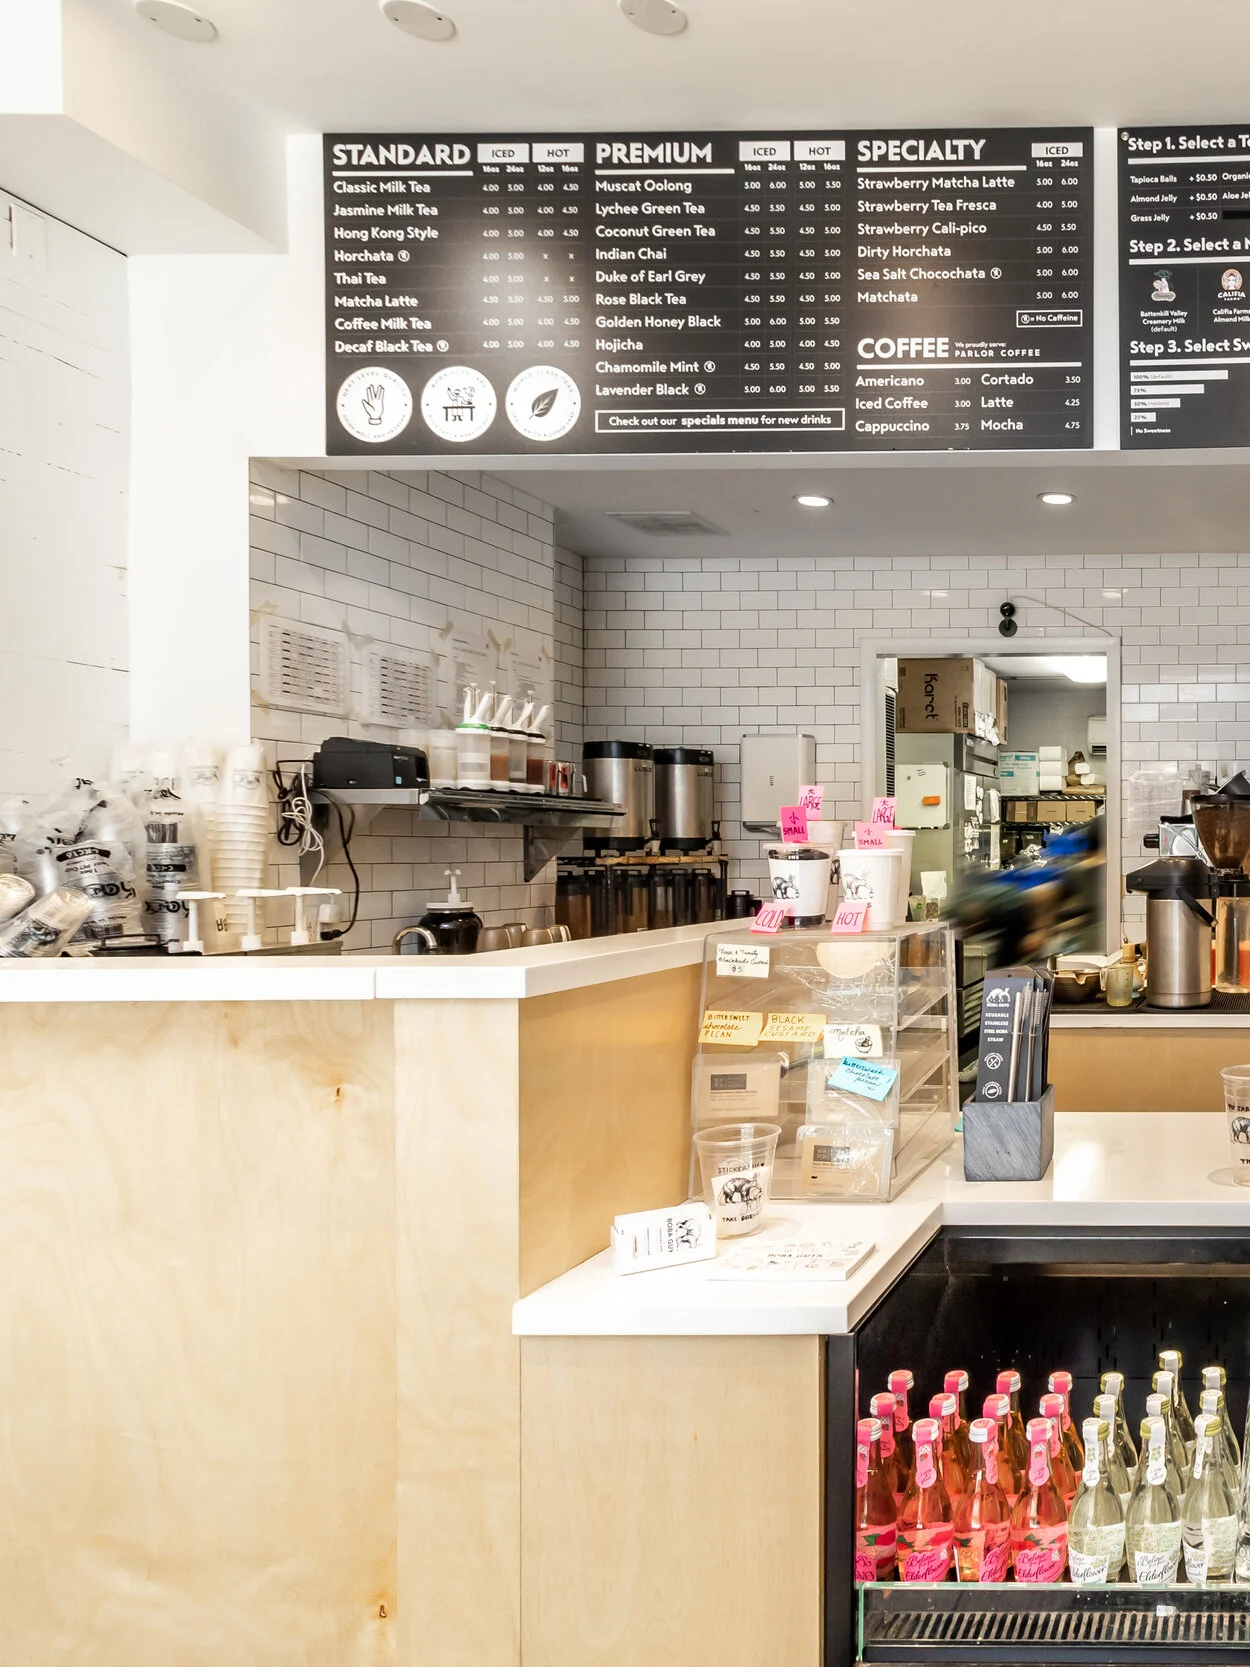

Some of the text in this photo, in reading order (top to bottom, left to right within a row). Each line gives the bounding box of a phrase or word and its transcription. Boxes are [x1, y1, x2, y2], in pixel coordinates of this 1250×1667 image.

[858, 140, 986, 161] SPECIALTY
[1045, 146, 1068, 155] ICED
[1128, 138, 1162, 153] Step
[1165, 137, 1175, 150] 1.
[1179, 136, 1224, 150] Select
[1228, 138, 1236, 147] a
[333, 144, 471, 166] STANDARD
[492, 150, 515, 158] ICED
[547, 150, 570, 158] HOT
[596, 142, 712, 163] PREMIUM
[596, 180, 641, 192] Muscat
[644, 179, 692, 193] Oolong
[769, 181, 786, 189] 6.00
[799, 181, 816, 189] 5.00
[825, 181, 841, 189] 5.50
[858, 176, 1078, 191] Strawberry Matcha Latte 5.00 6.00
[1130, 175, 1177, 184] Tapioca Balls
[333, 181, 578, 193] Classic Milk Tea 4.00 5.00 4.00 4.50
[333, 204, 438, 216] Jasmine Milk Tea
[596, 202, 705, 217] Lychee Green Tea
[334, 227, 439, 241] Hong Kong Style
[596, 248, 667, 260] Indian Chai
[858, 245, 951, 260] Dirty Horchata
[334, 273, 386, 284] Thai Tea
[858, 268, 985, 281] Sea Salt Chocochata
[596, 315, 721, 330] Golden Honey Black
[1048, 314, 1078, 322] Caffeine
[858, 337, 949, 358] COFFEE
[955, 349, 1040, 358] PARLOR COFFEE
[1130, 341, 1164, 357] Step
[1167, 340, 1181, 353] 3.
[1185, 338, 1230, 353] Select
[856, 375, 971, 387] Americano 3.00
[981, 373, 1081, 386] Cortado 3.50
[609, 415, 831, 427] Check out our specials menu for new drinks
[800, 796, 822, 810] LARGE
[873, 806, 894, 823] LARGE
[783, 827, 805, 835] SMALL
[755, 910, 785, 928] COLD
[837, 912, 862, 927] HOT
[772, 1015, 804, 1024] BLACK
[704, 1030, 731, 1038] PECAN
